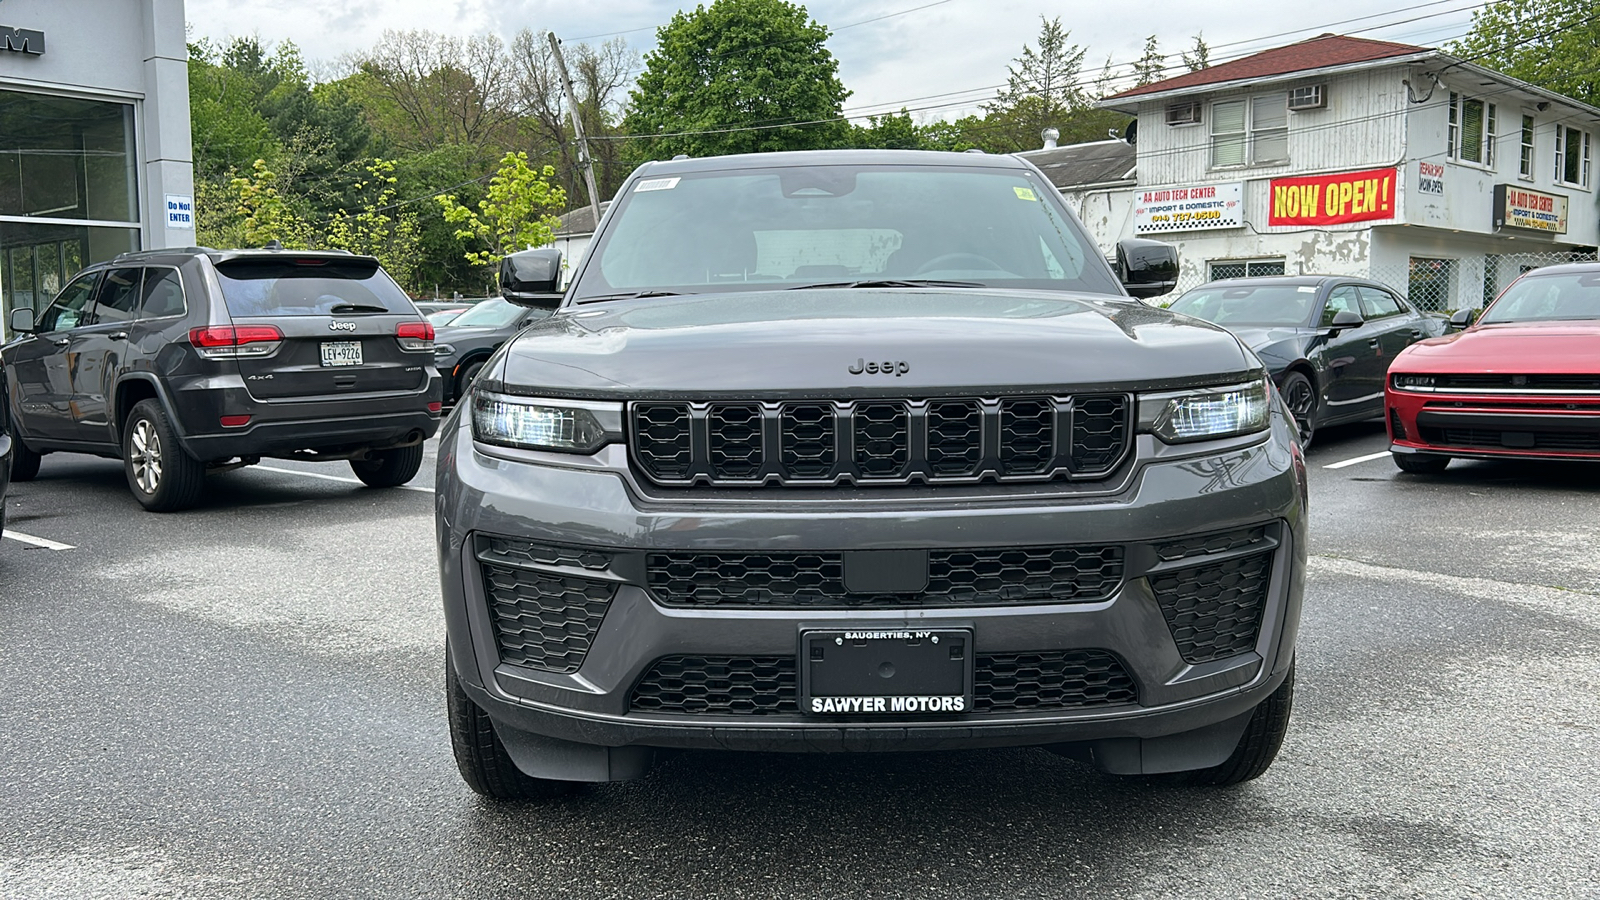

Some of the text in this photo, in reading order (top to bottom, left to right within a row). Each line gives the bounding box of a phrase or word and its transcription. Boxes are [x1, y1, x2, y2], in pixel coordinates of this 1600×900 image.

[1143, 187, 1216, 204] AA AUTO TECH CENTER
[1274, 184, 1320, 218] NOW
[168, 201, 191, 211] Do Not
[1149, 205, 1178, 214] IMPORT
[1185, 201, 1225, 210] DOMESTIC
[169, 212, 190, 222] ENTER
[328, 320, 357, 332] Jeep
[341, 347, 360, 360] 9226
[848, 357, 910, 377] Jeep
[844, 632, 914, 640] SAUGERTIES,
[811, 696, 965, 713] SAWYER MOTORS
